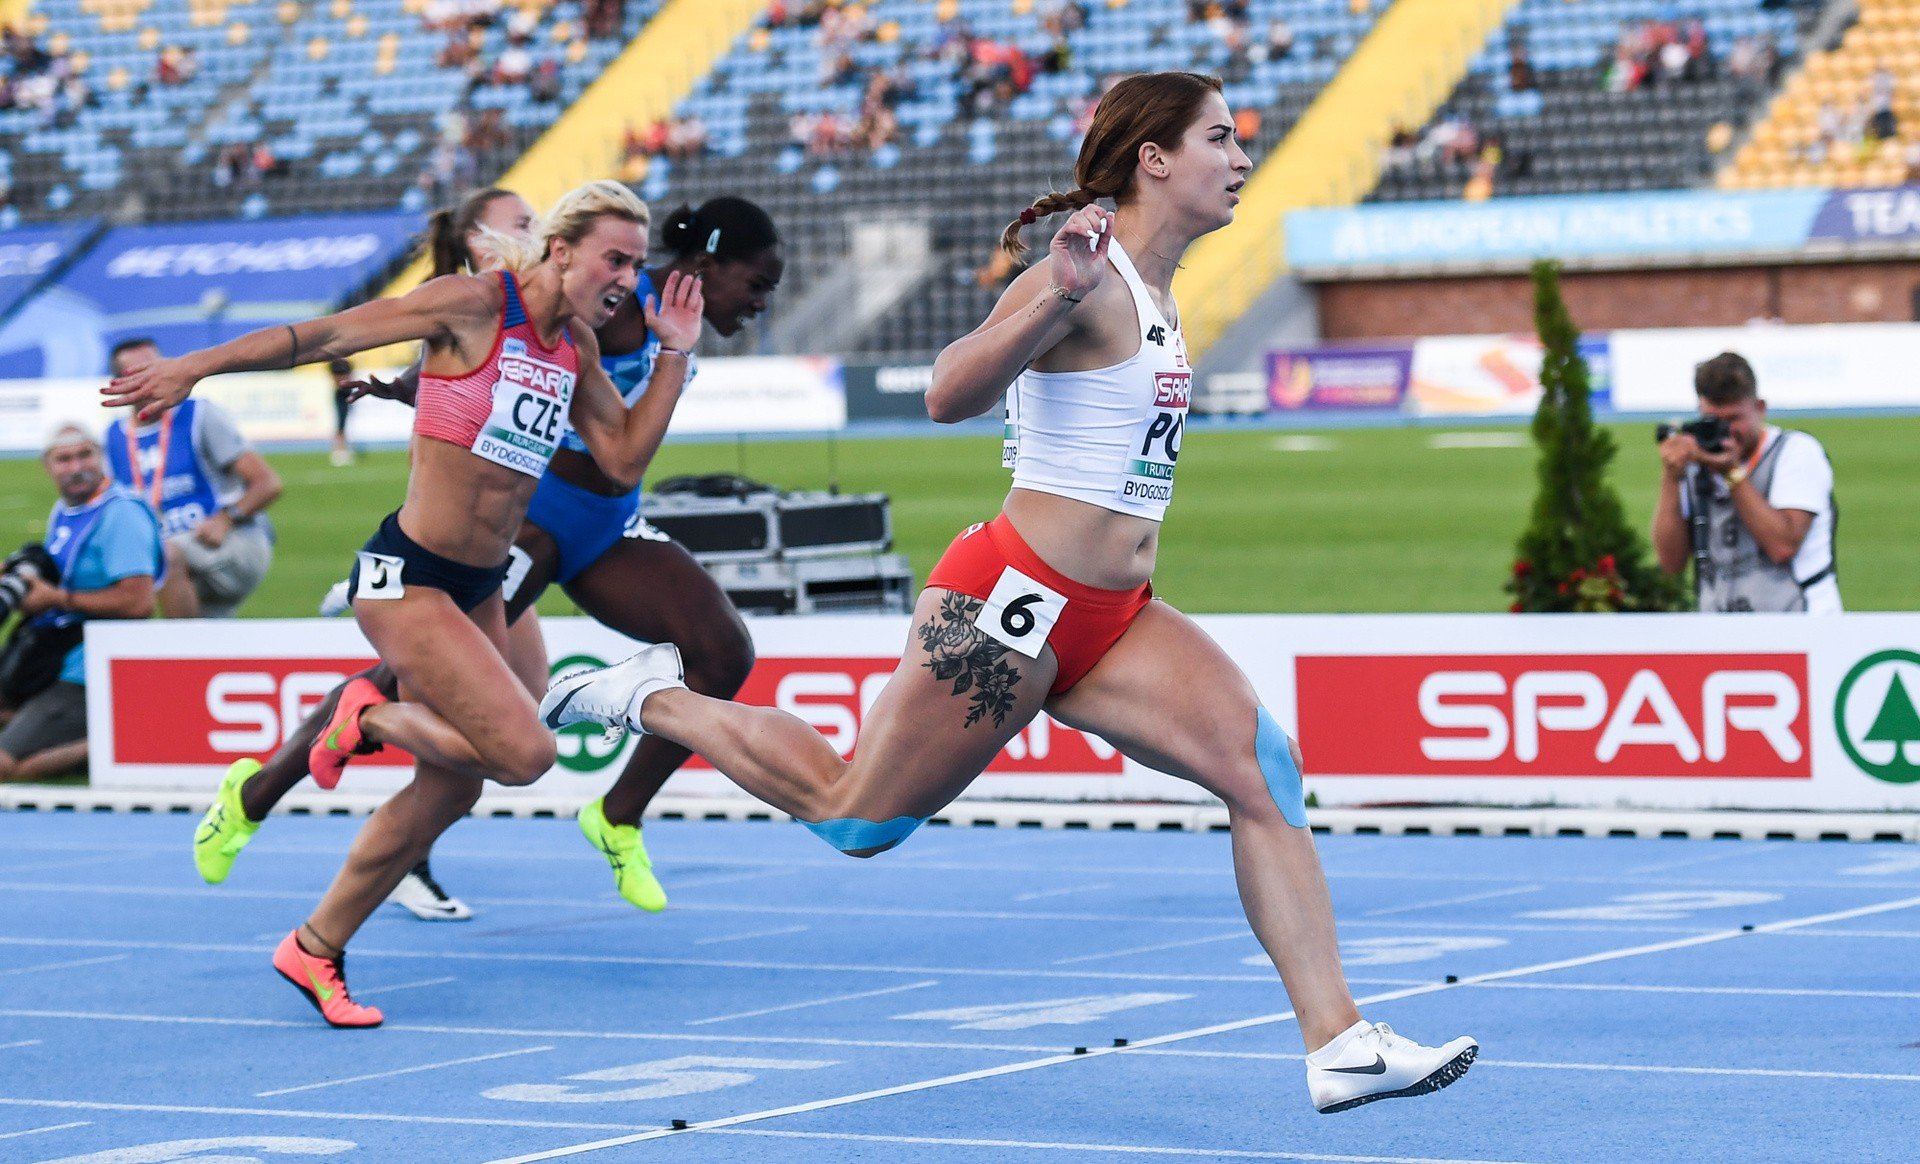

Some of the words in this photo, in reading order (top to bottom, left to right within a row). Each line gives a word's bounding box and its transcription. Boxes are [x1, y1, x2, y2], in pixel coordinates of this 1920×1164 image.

[1147, 324, 1165, 346] 4F
[1157, 377, 1188, 402] SPAR
[512, 393, 561, 442] CZE
[1149, 463, 1165, 477] RUN
[1000, 593, 1045, 637] 6
[1418, 669, 1802, 763] SPAR
[480, 1055, 846, 1103] 5
